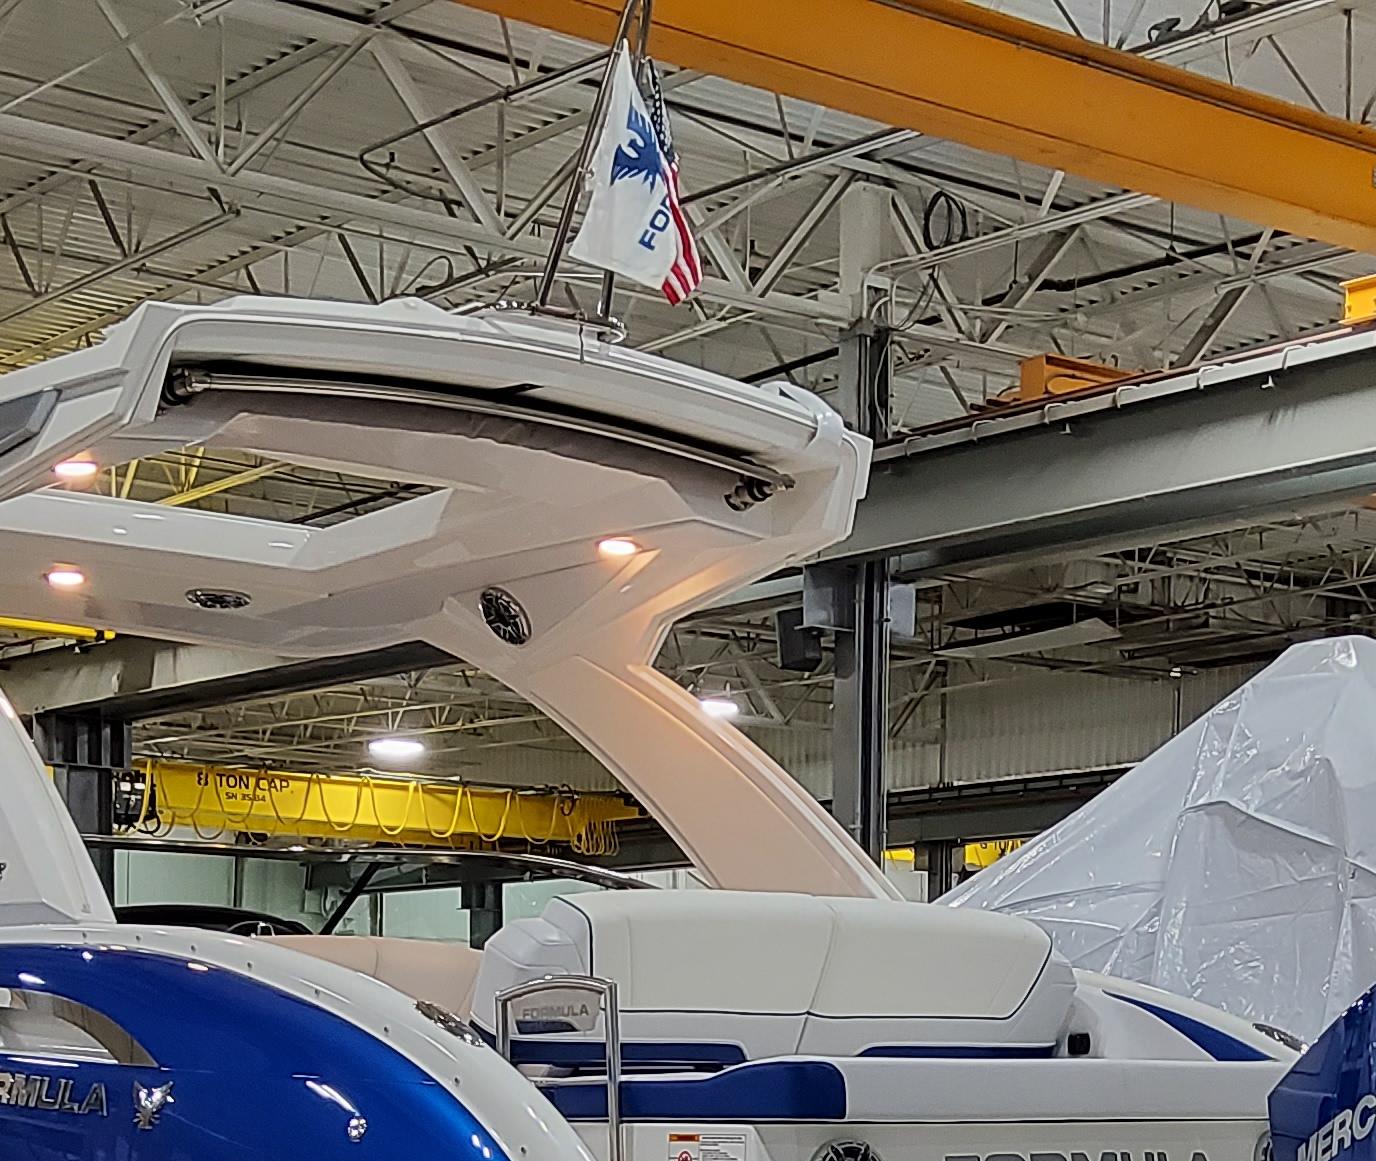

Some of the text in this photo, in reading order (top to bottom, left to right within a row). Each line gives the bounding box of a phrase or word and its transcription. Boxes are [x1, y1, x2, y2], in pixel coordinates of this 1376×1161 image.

[197, 771, 209, 787] 8
[216, 773, 250, 790] TON
[523, 1003, 590, 1018] FORMULA
